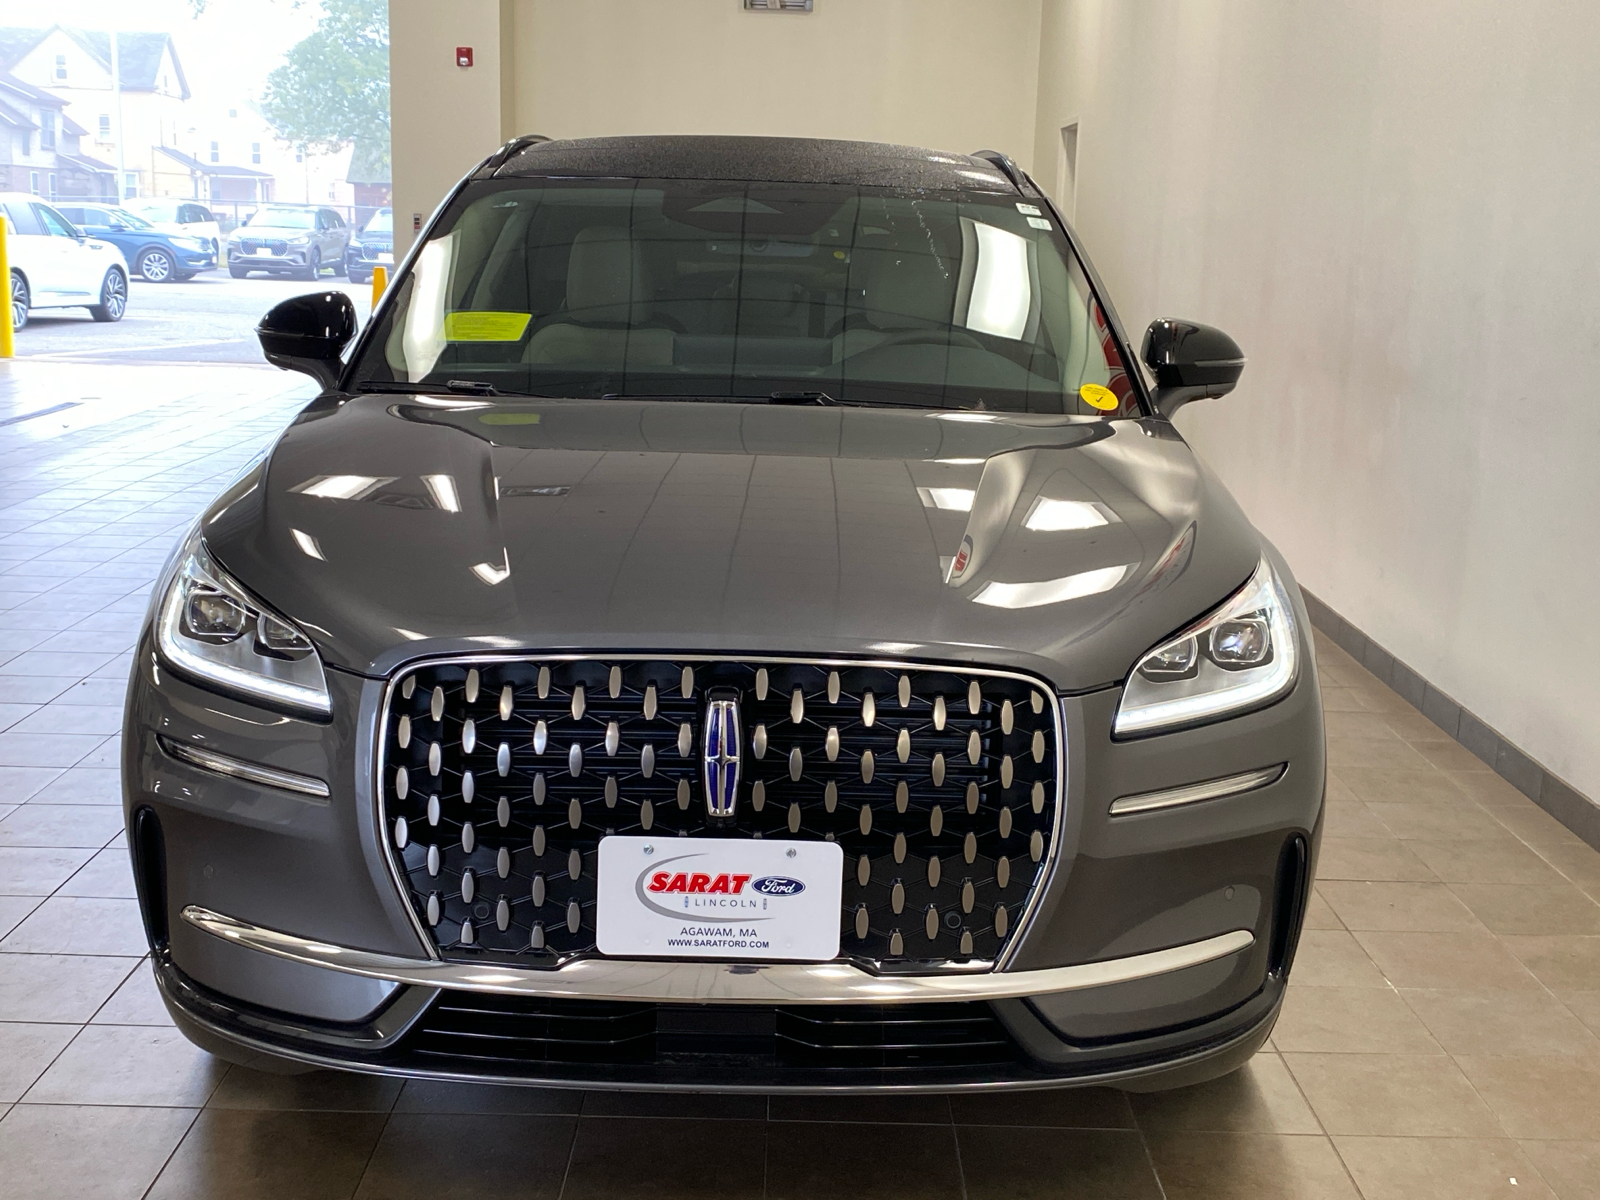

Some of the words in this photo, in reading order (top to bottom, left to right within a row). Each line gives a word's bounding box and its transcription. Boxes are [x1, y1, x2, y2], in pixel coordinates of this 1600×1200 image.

[647, 871, 752, 895] SARAT
[760, 878, 797, 895] Ford
[694, 898, 758, 909] LINCOLN
[680, 927, 736, 938] AGAWAM,
[739, 928, 758, 938] MA
[667, 938, 770, 949] WWW.SARATFORD.COM
